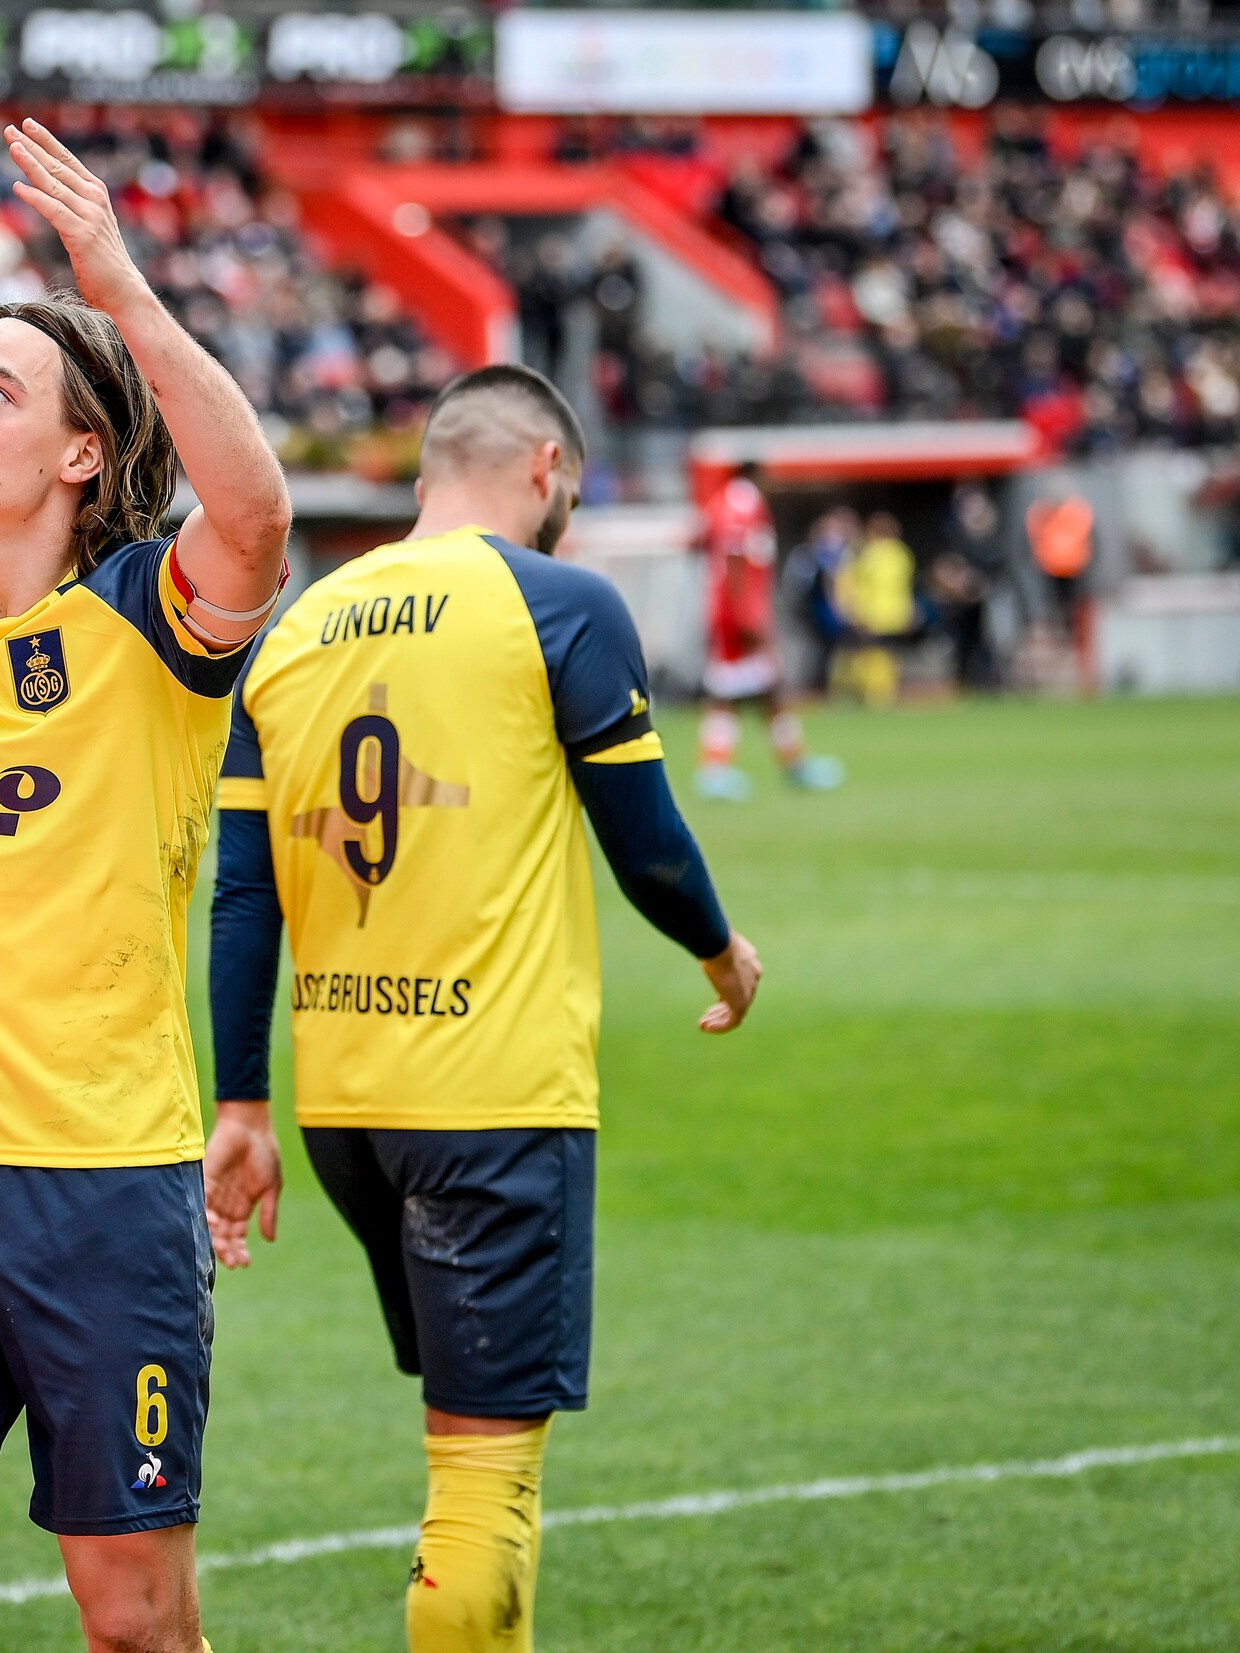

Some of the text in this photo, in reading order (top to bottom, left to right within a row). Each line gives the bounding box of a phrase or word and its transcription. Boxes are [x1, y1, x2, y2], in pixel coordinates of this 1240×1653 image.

[320, 594, 449, 645] UNDAV
[25, 675, 60, 699] USG
[340, 715, 399, 886] 9
[135, 1363, 169, 1447] 6
